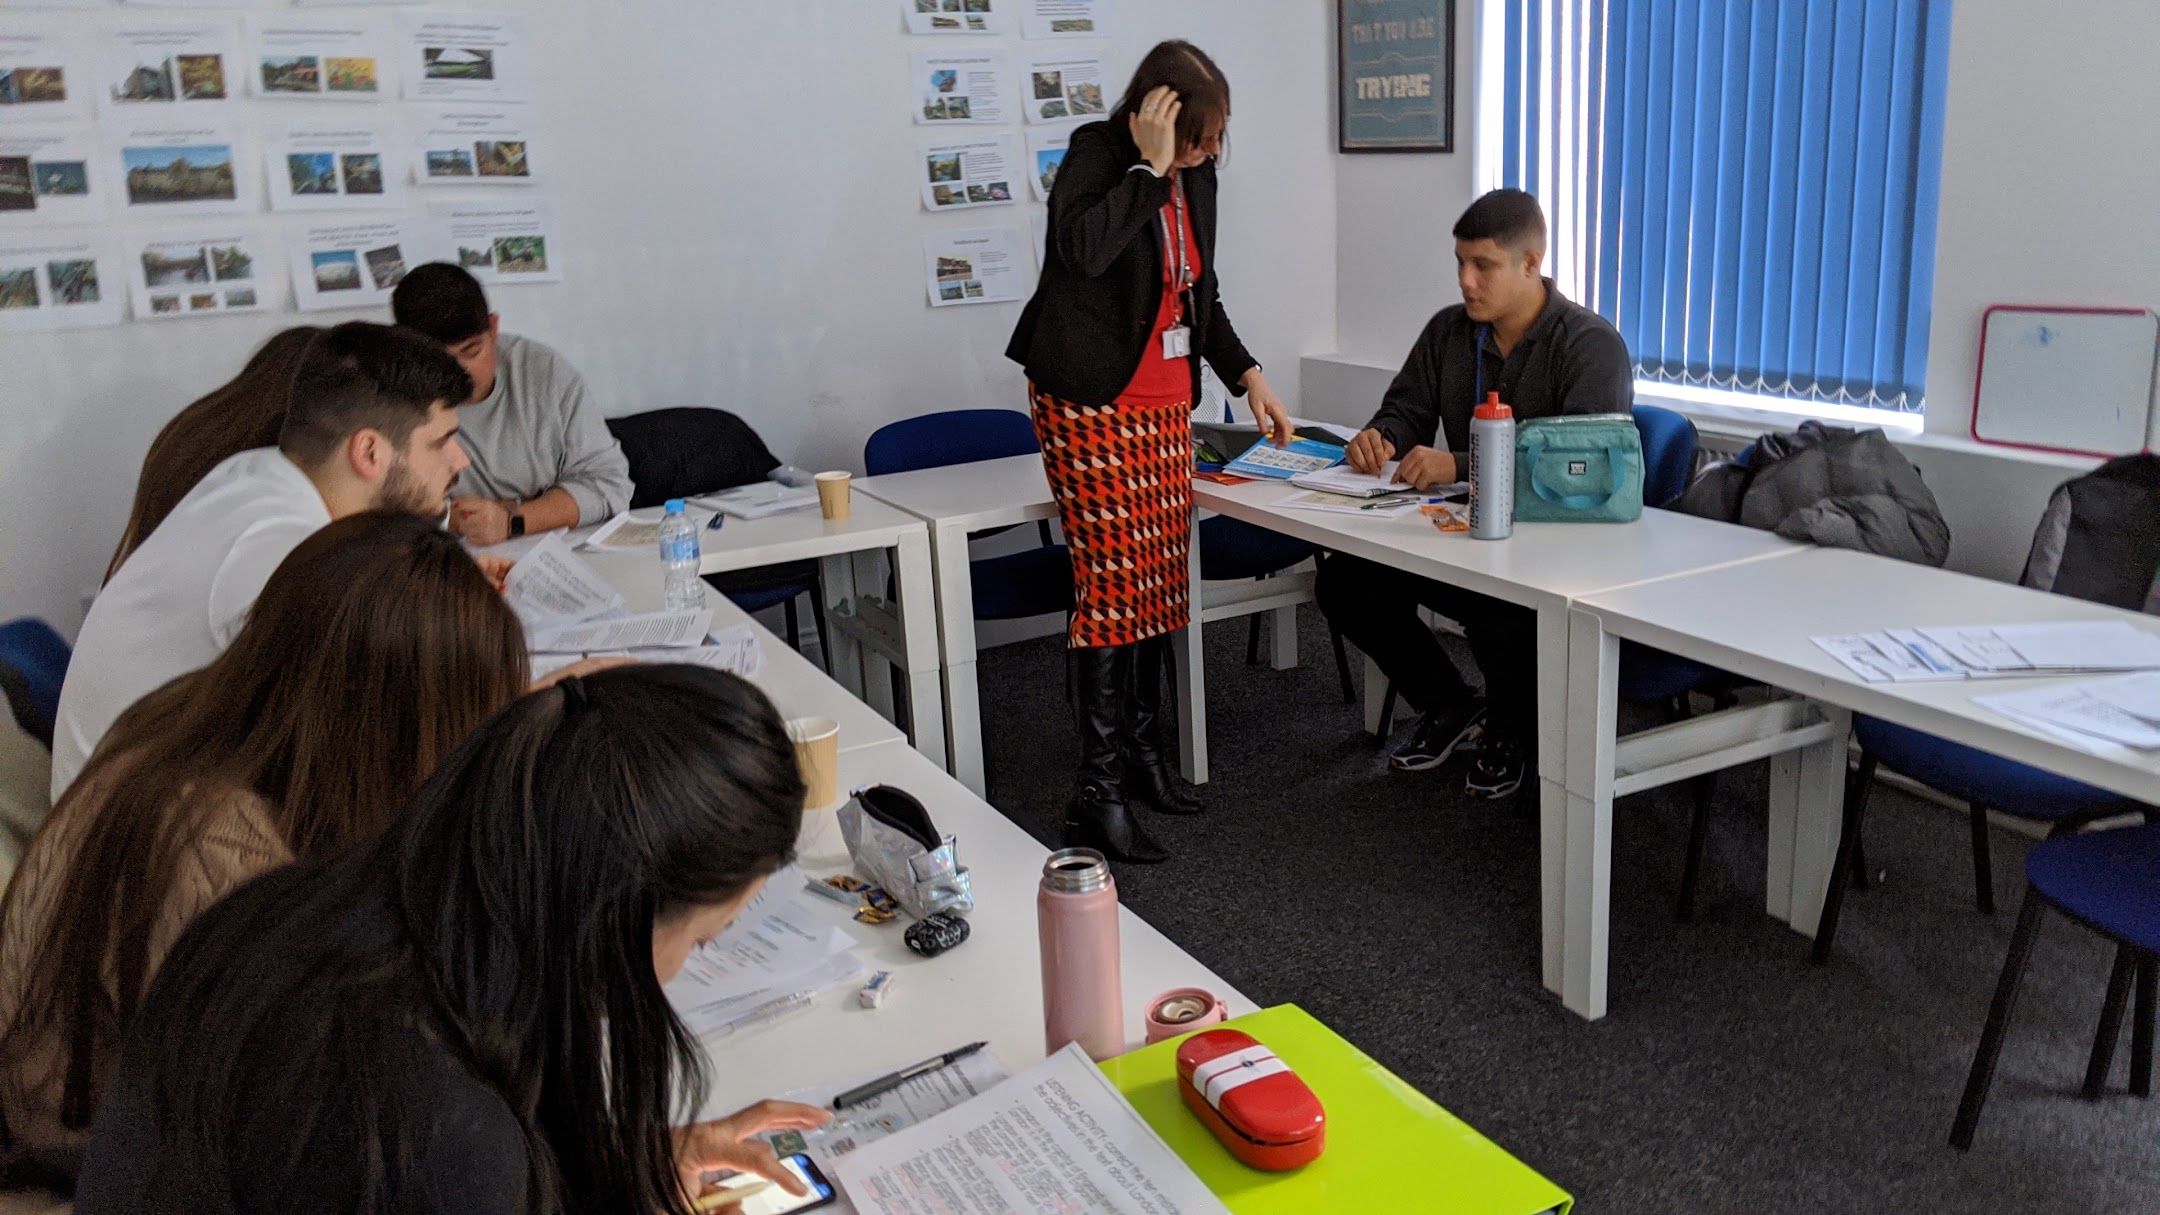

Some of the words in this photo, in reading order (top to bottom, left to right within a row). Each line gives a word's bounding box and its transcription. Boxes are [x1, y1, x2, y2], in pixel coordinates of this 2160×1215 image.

[1356, 73, 1431, 99] TRYING
[1032, 1084, 1050, 1098] the
[1042, 1096, 1082, 1134] adjectives
[1082, 1138, 1100, 1153] the
[1094, 1150, 1113, 1167] text
[1107, 1165, 1134, 1190] about
[1044, 1076, 1081, 1111] LISTENING
[1103, 1140, 1134, 1169] correct
[1128, 1166, 1146, 1181] the
[1140, 1179, 1158, 1194] ten
[1153, 1191, 1181, 1215] mista
